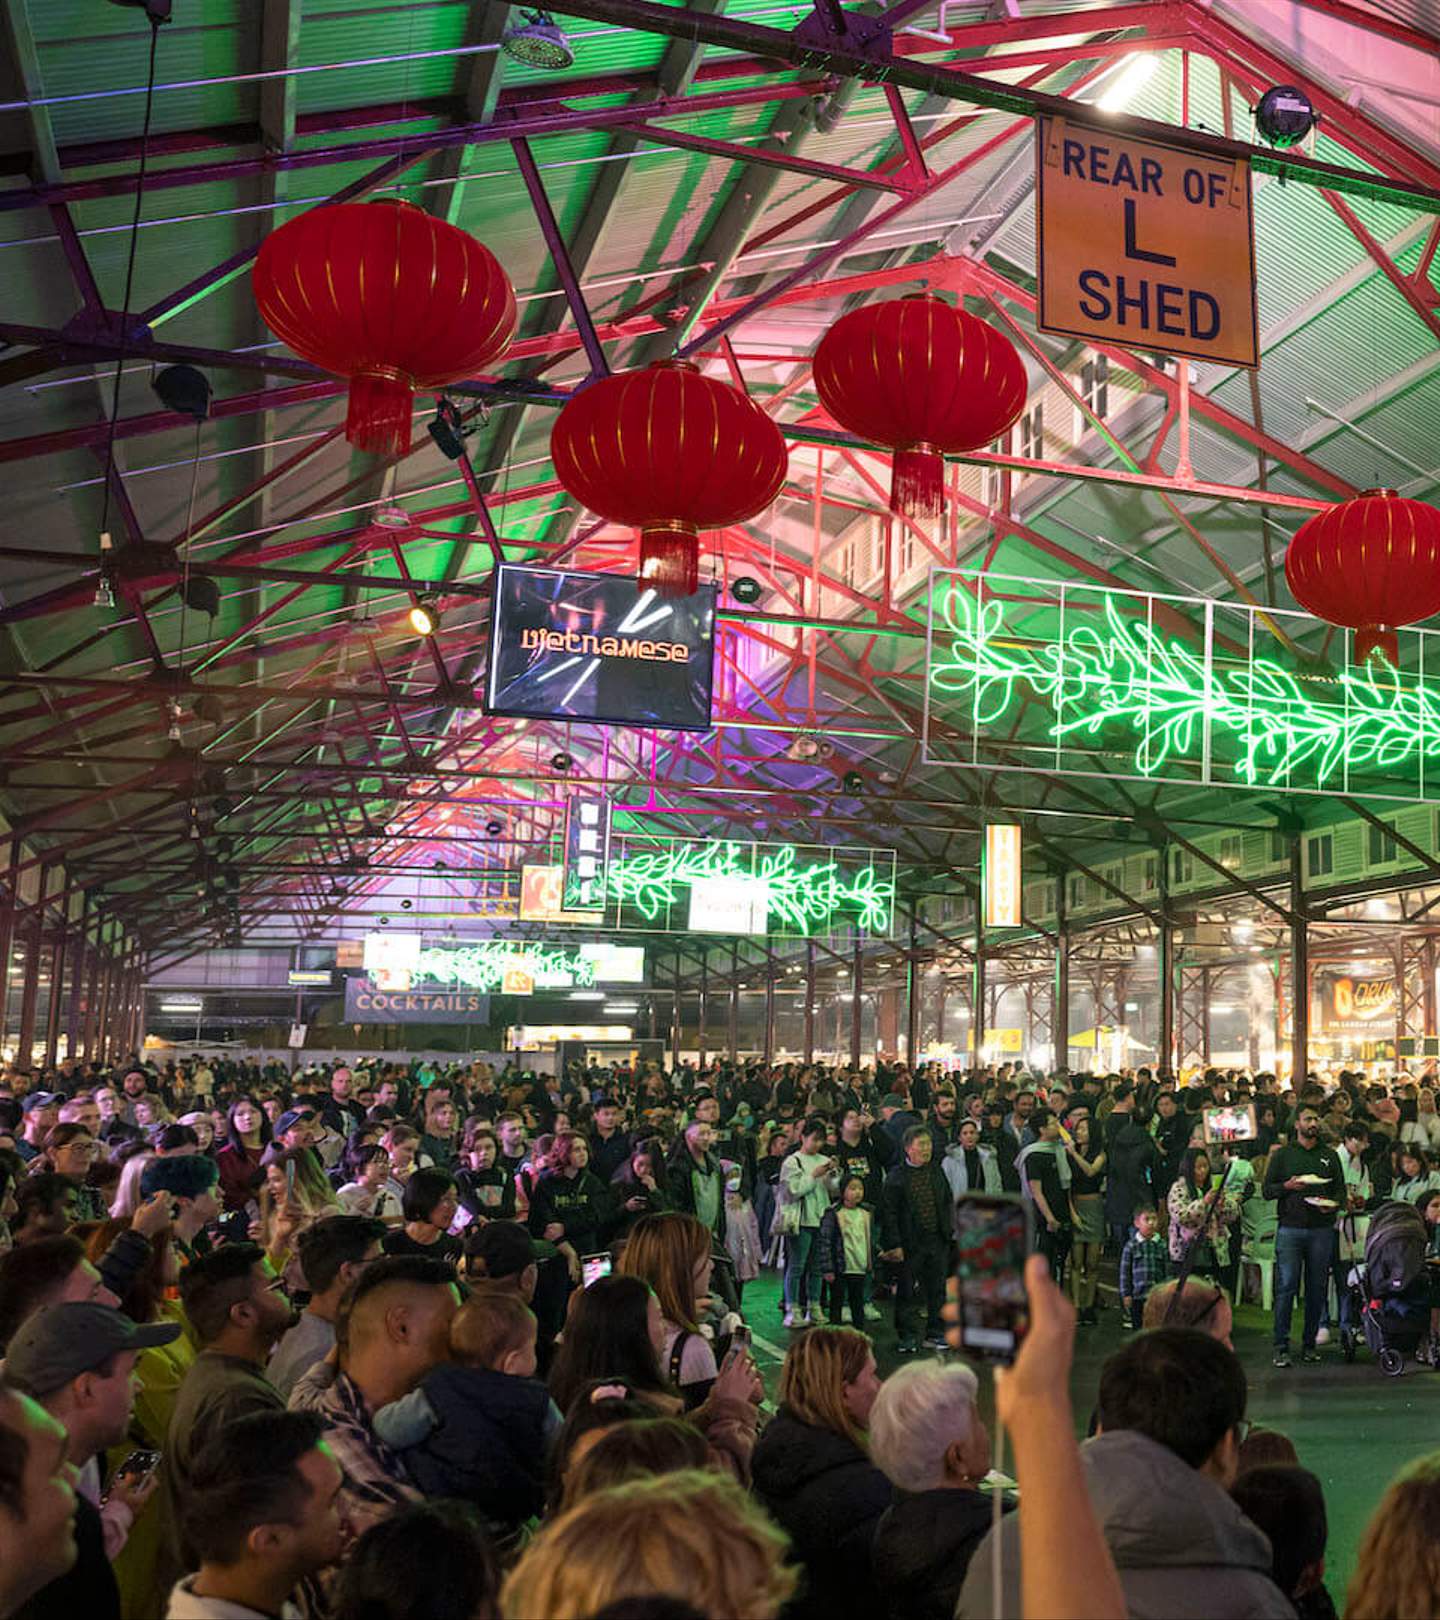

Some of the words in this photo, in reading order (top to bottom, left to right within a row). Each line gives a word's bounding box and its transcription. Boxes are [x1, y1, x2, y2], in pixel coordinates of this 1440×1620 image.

[1064, 139, 1164, 196] REAR
[1184, 168, 1227, 208] OF
[1124, 199, 1176, 267] L
[1079, 270, 1221, 341] SHED
[356, 994, 480, 1011] COCKTAILS
